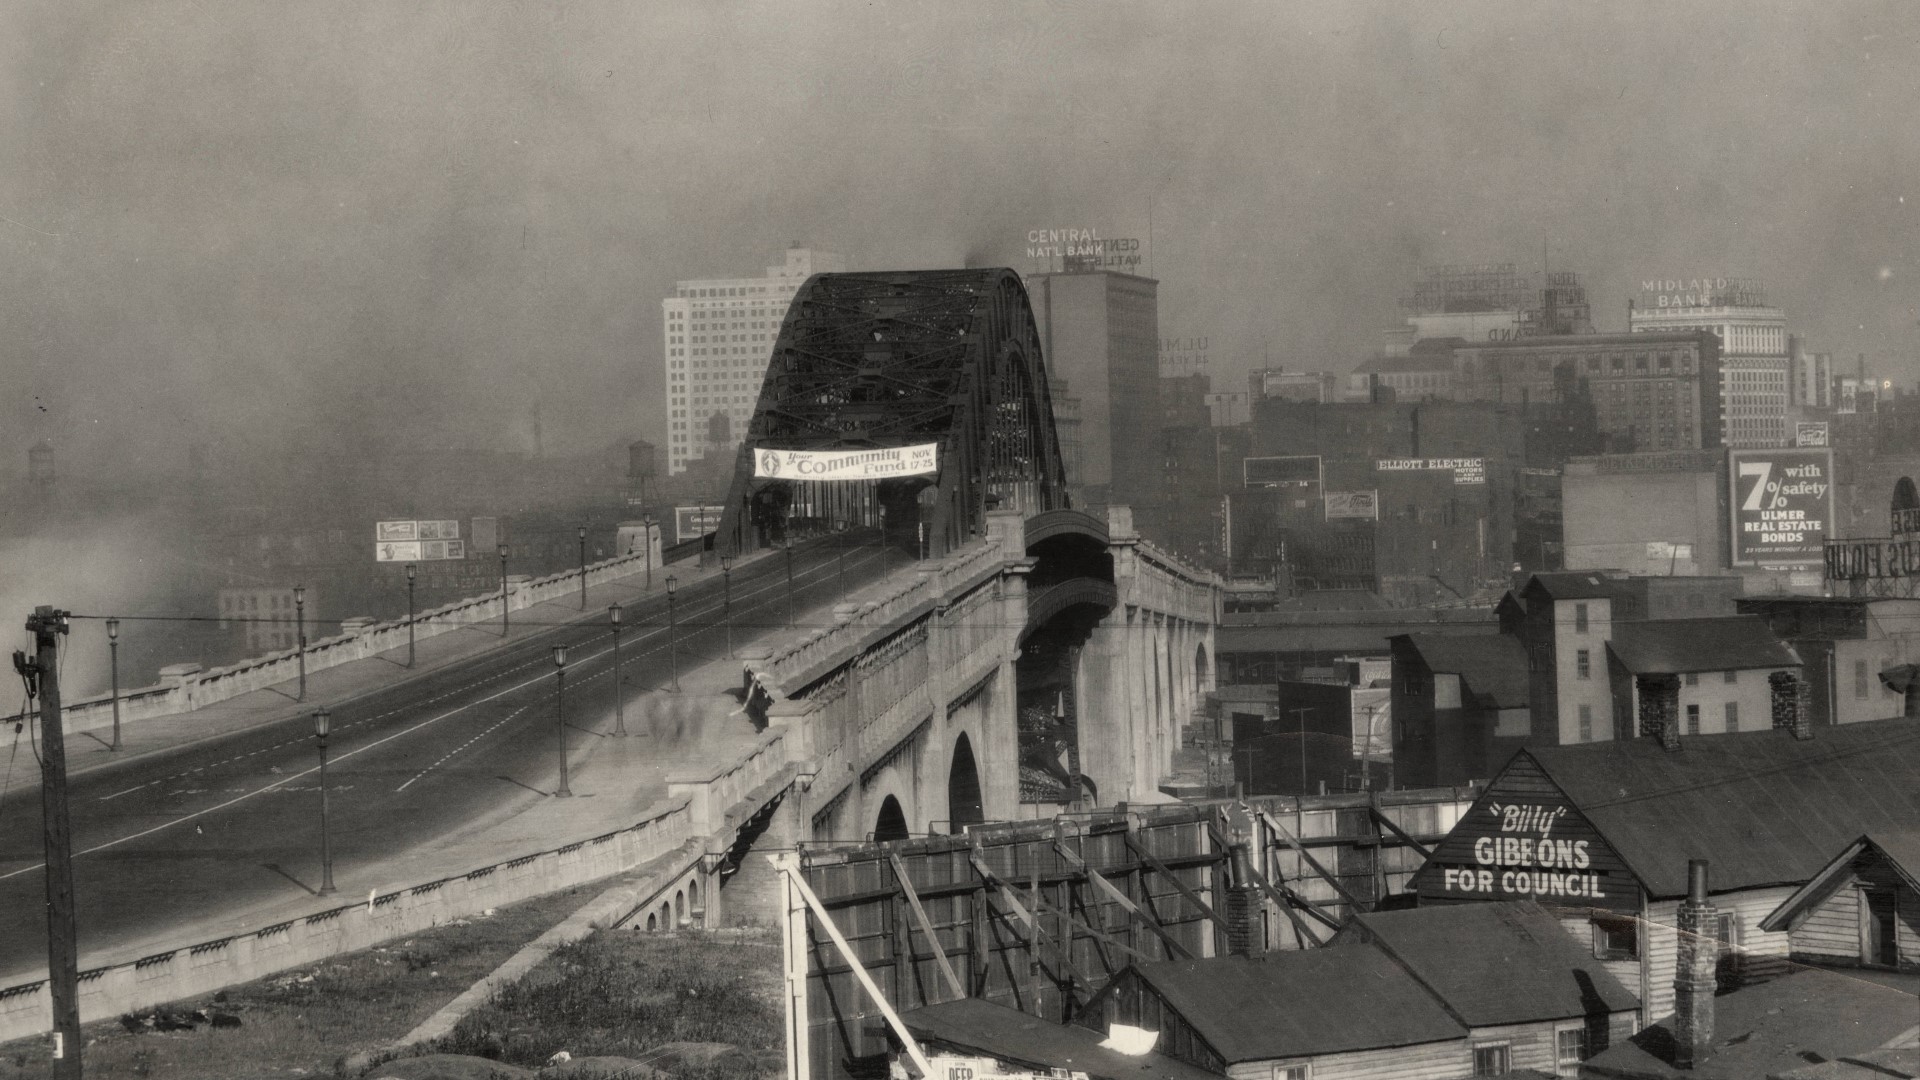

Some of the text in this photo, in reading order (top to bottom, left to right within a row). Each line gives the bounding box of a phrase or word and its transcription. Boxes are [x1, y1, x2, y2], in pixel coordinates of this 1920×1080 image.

[1028, 227, 1101, 243] CENTRAL
[1067, 245, 1103, 256] BANK
[1642, 278, 1727, 291] MIDLAND
[1658, 294, 1710, 307] BANK
[797, 449, 900, 475] Community
[864, 459, 906, 474] Fund
[1378, 458, 1482, 470] ELLIOTT ELECTRIC
[1785, 464, 1822, 478] with
[1739, 461, 1788, 510] 7%
[1782, 481, 1828, 500] safety
[1761, 510, 1805, 520] ULMER
[1744, 520, 1822, 532] REAL ESTATE
[1761, 532, 1804, 543] BONDS
[1474, 837, 1590, 869] GIBBONS
[1444, 868, 1606, 898] FOR COUNCIL
